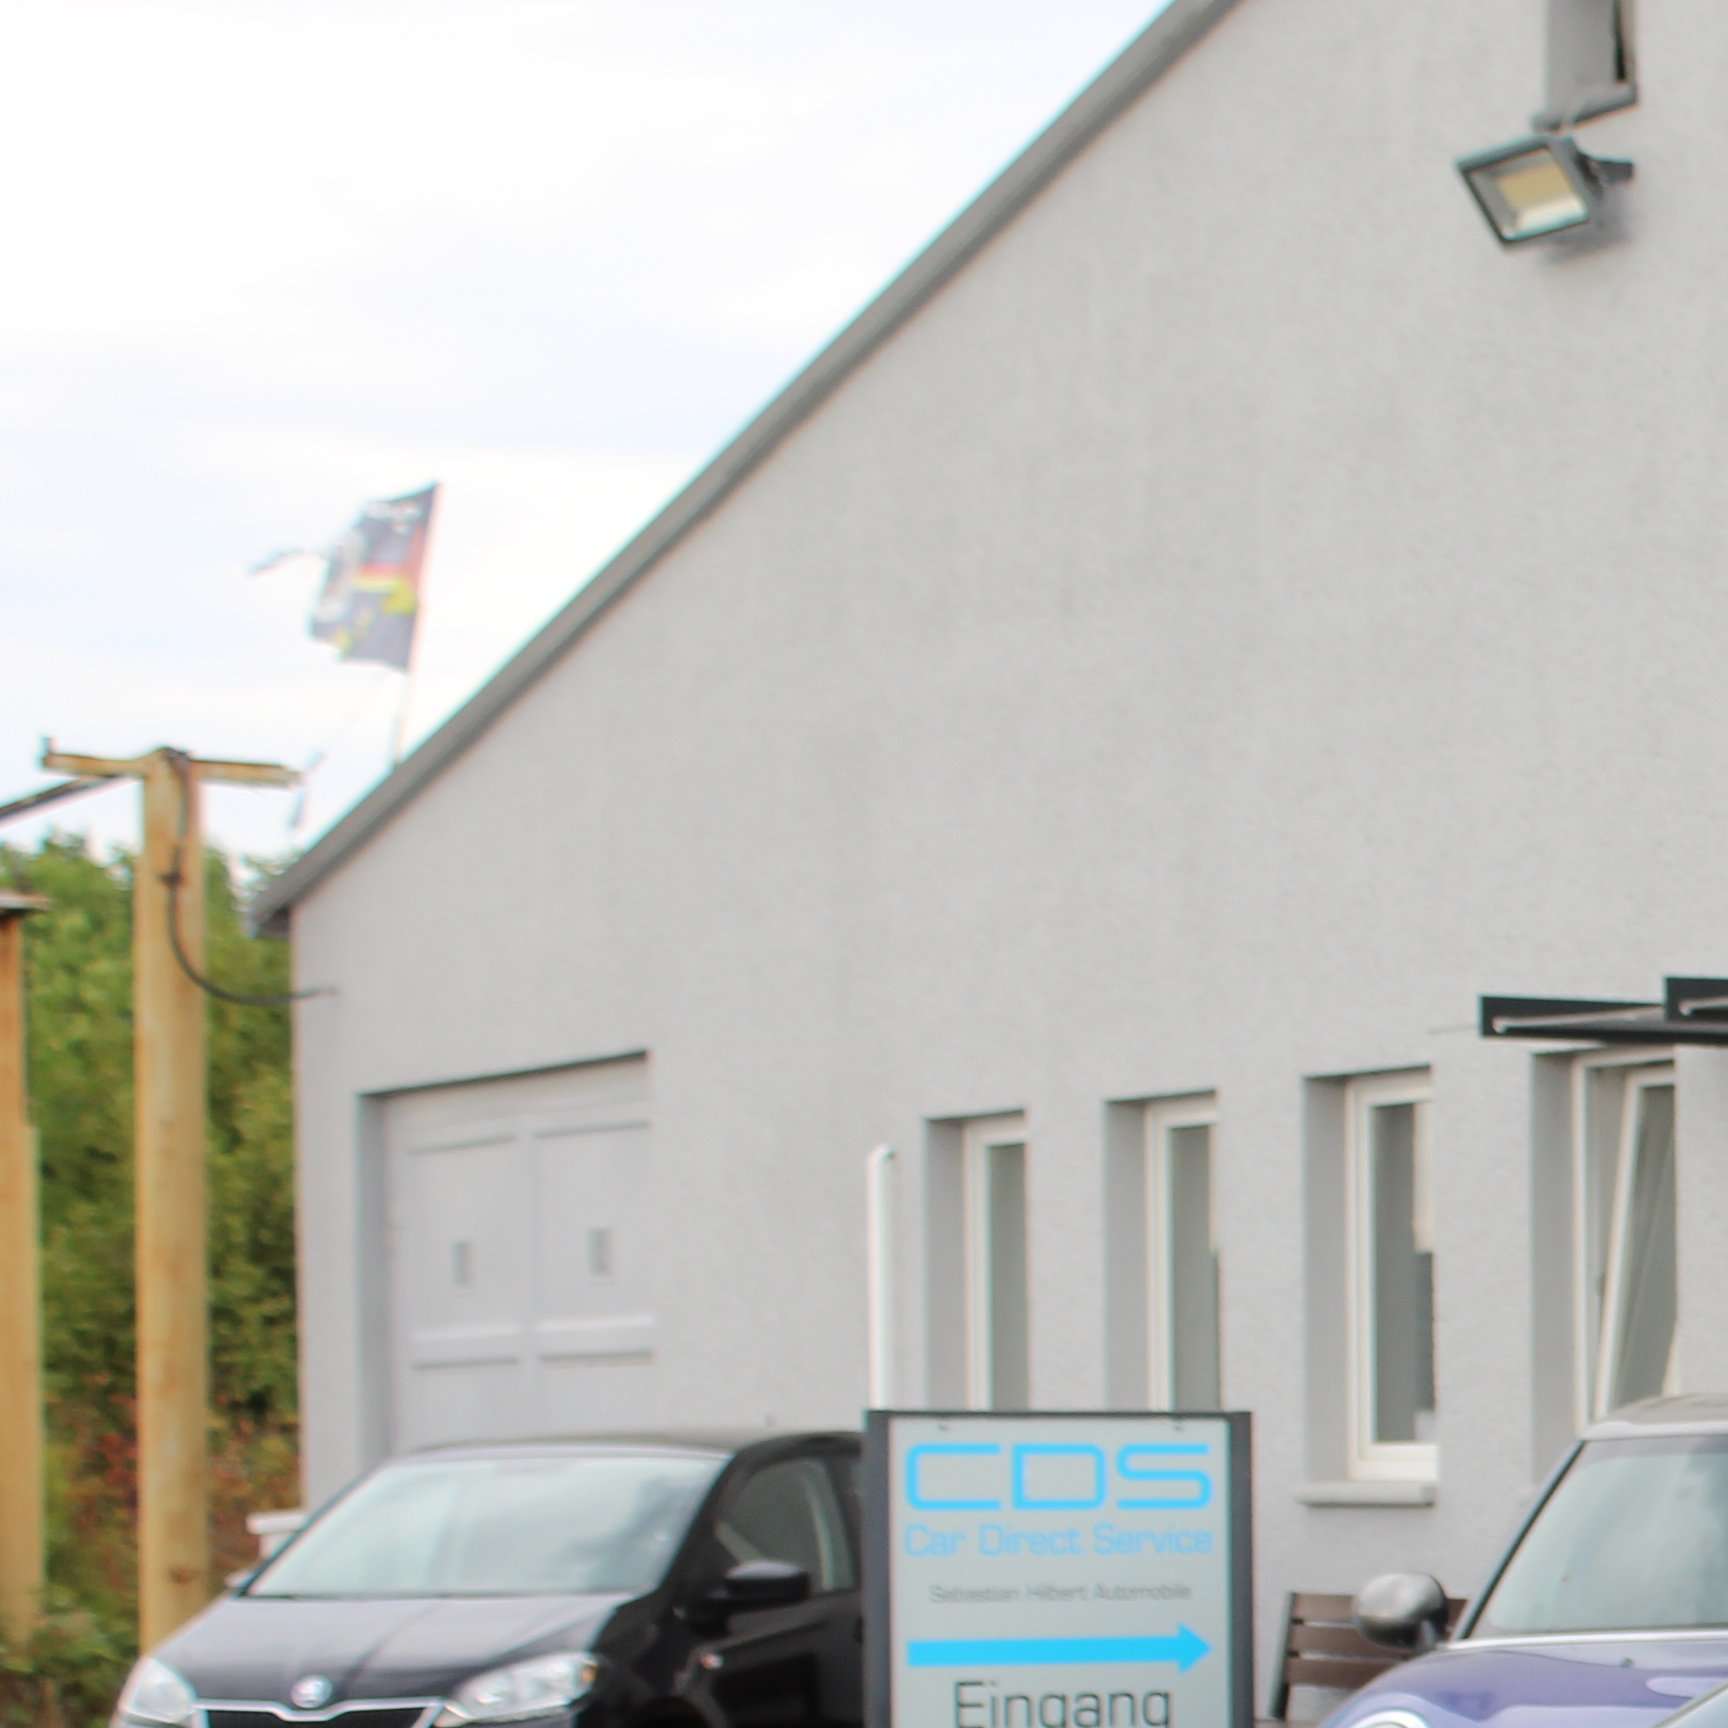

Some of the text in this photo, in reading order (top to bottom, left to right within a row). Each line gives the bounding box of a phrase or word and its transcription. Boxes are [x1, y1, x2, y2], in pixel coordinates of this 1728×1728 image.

[906, 1443, 1213, 1511] CDS
[905, 1521, 1213, 1557] Car Direct Service
